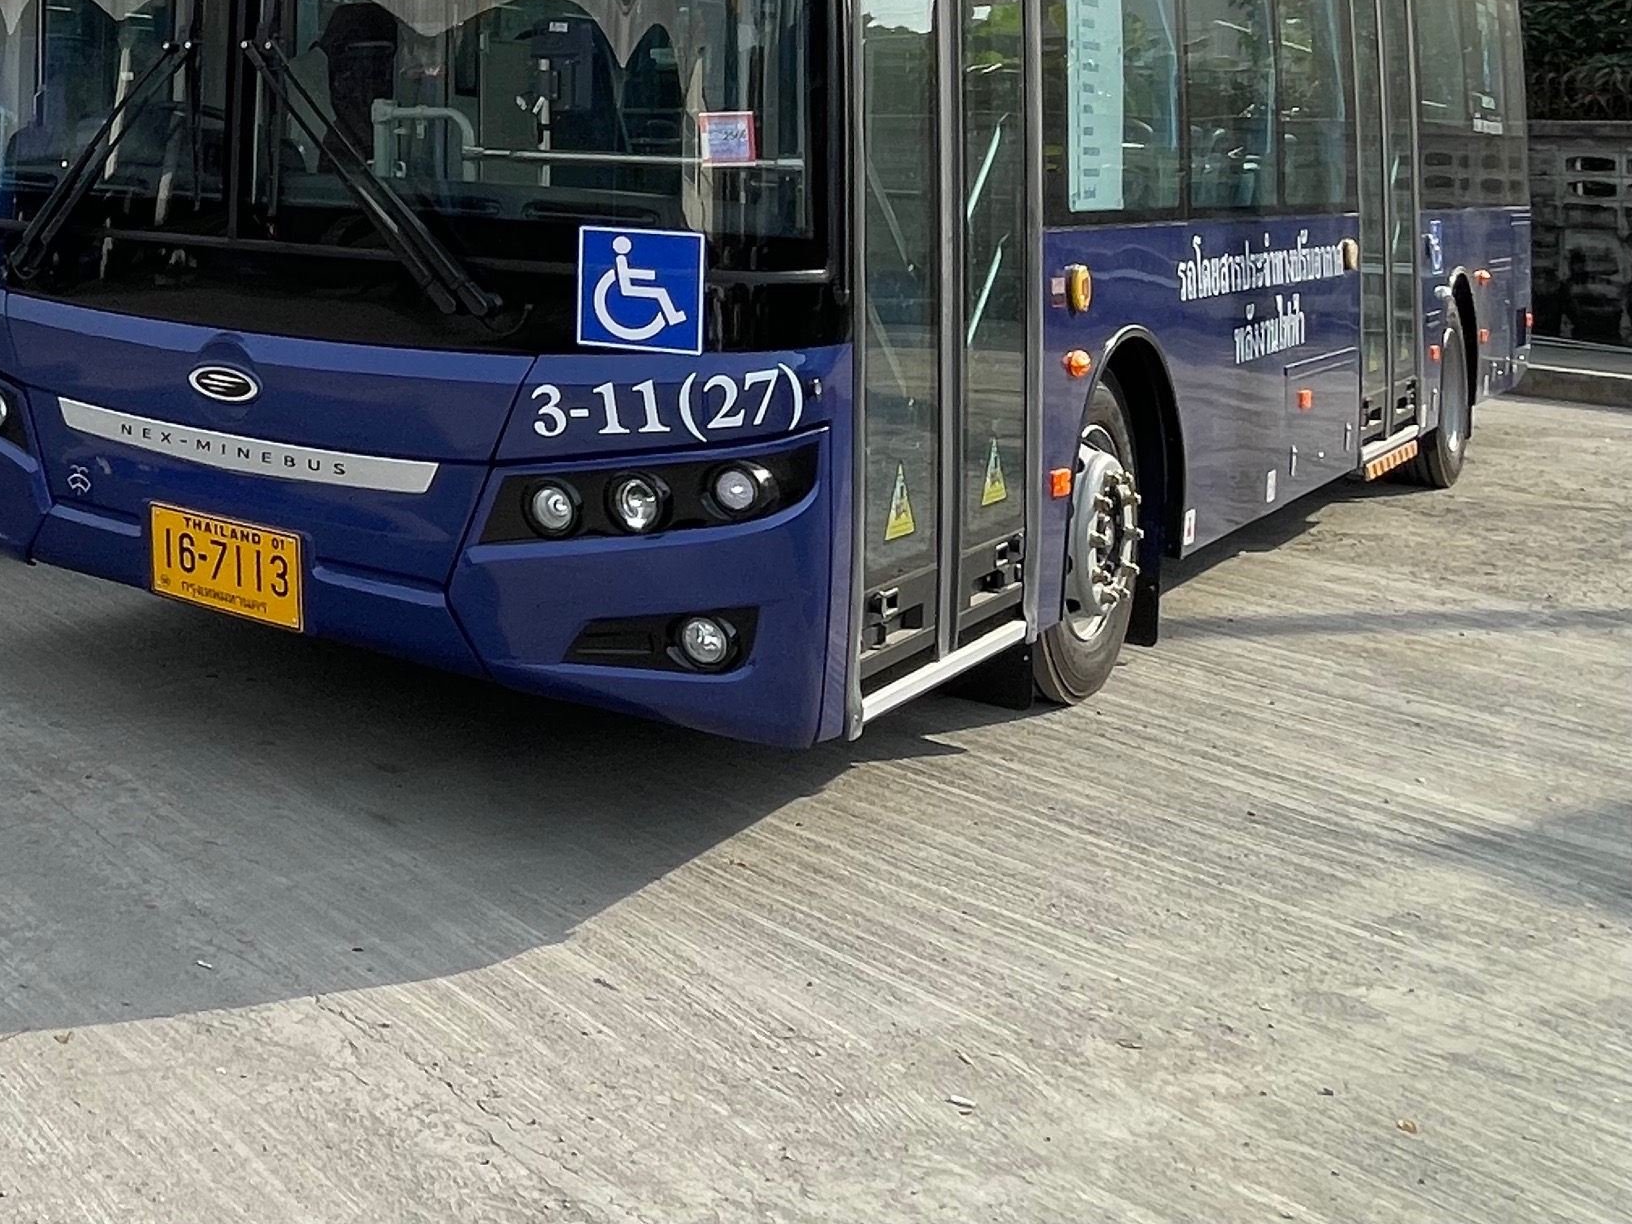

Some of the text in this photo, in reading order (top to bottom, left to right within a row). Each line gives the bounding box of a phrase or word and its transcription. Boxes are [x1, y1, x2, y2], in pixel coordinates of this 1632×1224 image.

[530, 362, 804, 442] 3-11(27)
[120, 423, 346, 476] NEX-MINEBUS
[165, 528, 289, 598] 16-7113
[183, 516, 285, 551] THAILAND 01
